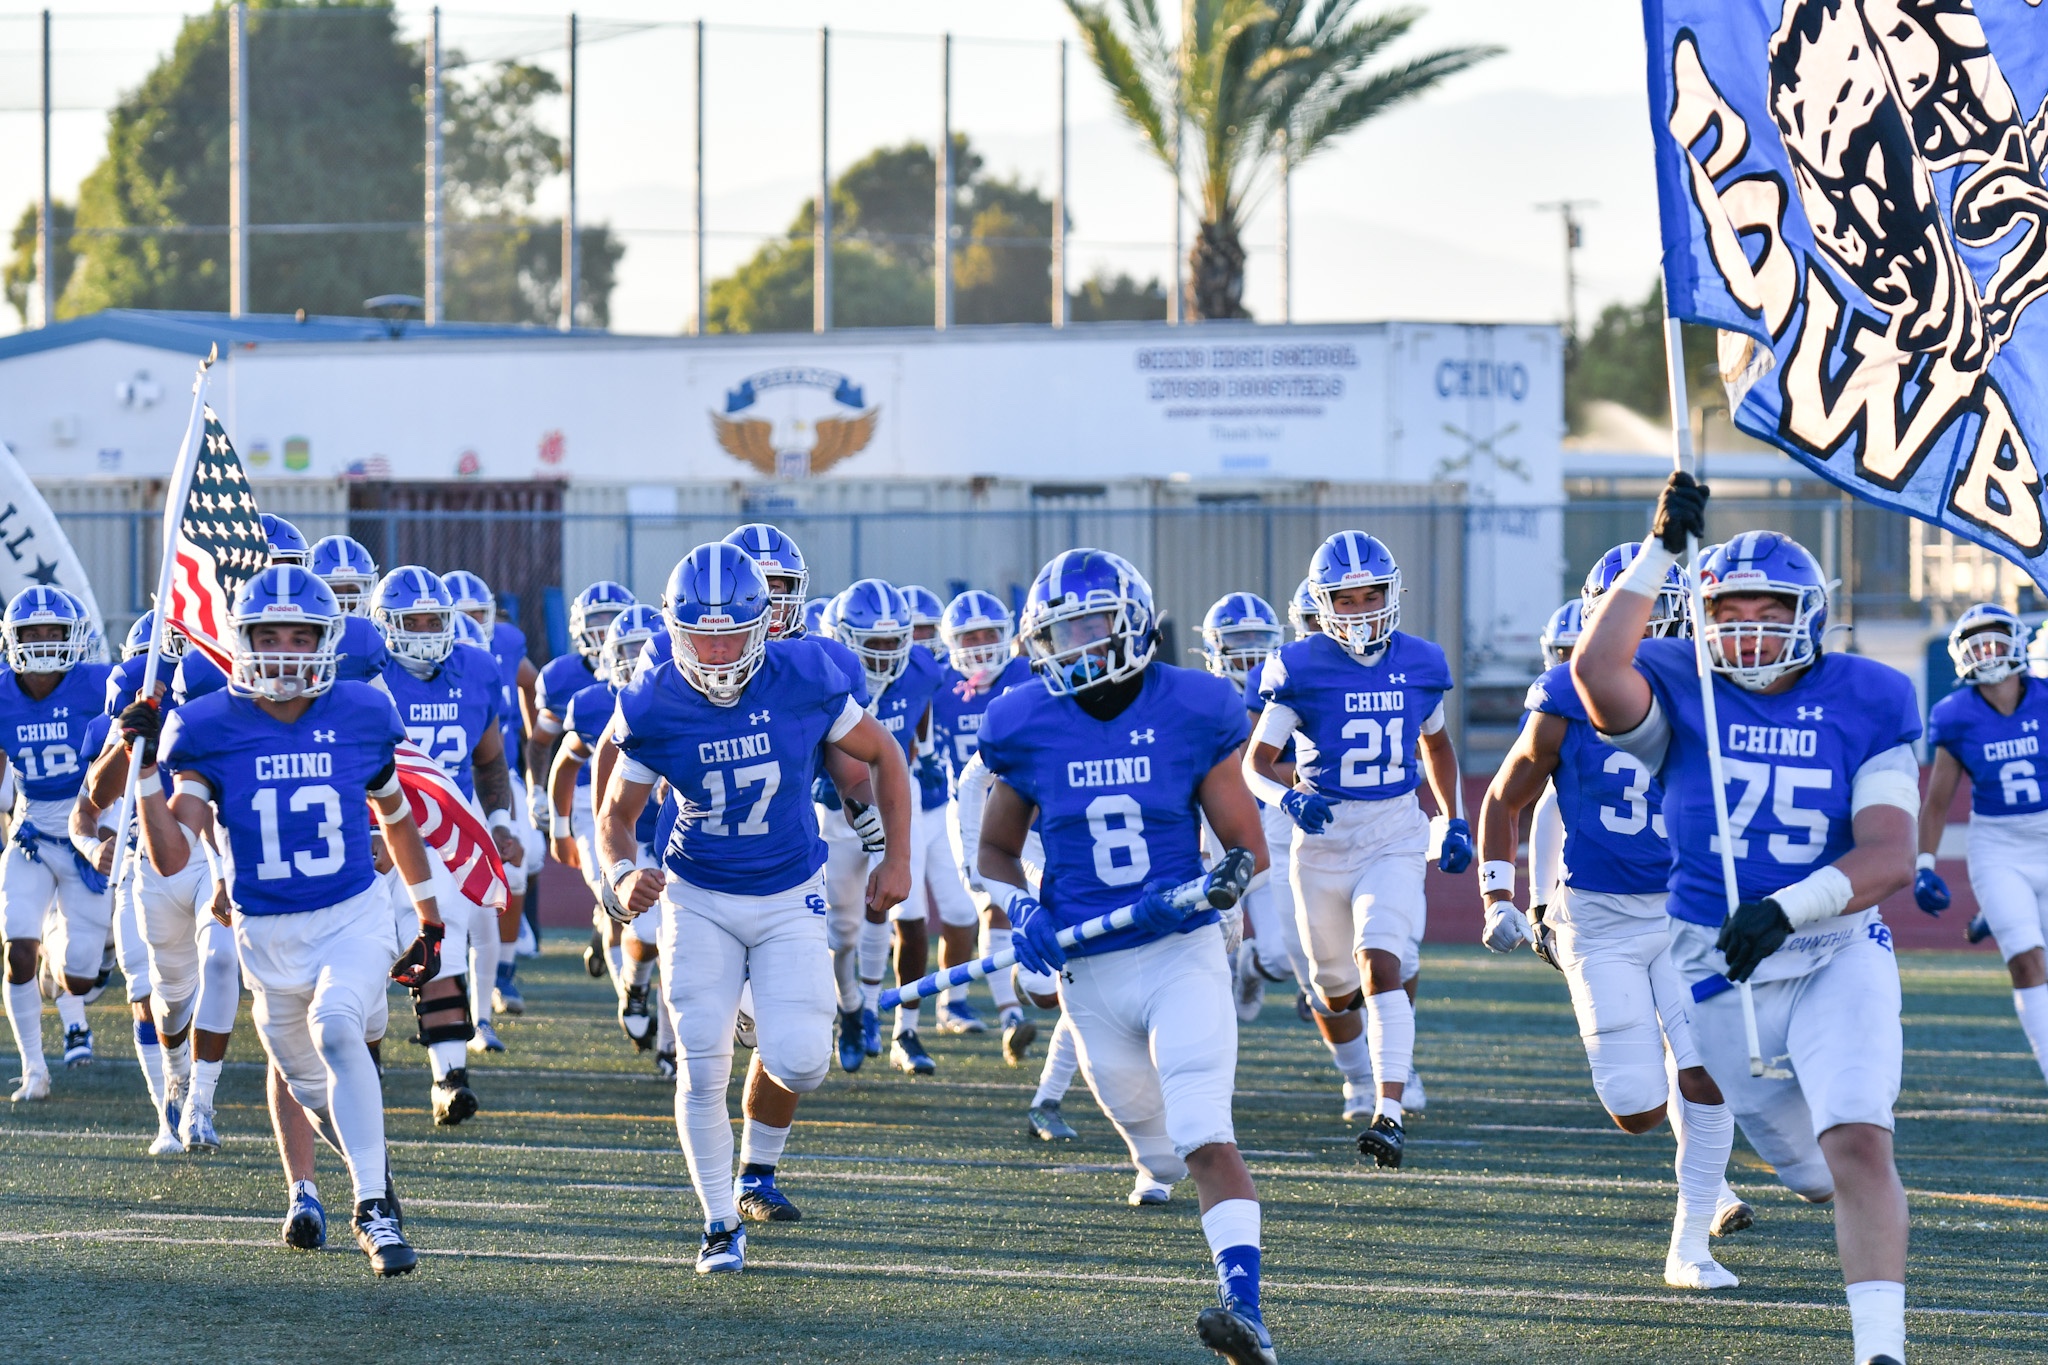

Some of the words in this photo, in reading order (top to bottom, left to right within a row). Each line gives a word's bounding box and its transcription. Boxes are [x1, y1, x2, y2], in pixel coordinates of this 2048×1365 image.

[1210, 346, 1265, 369] HIGH
[1269, 344, 1358, 368] SCHOOL
[1435, 359, 1530, 400] CHINO
[409, 703, 459, 721] CHINO
[1344, 690, 1404, 713] CHINO
[16, 722, 69, 742] CHINO
[698, 732, 771, 764] CHINO
[1728, 723, 1818, 758] CHINO
[1983, 735, 2039, 762] CHINO
[255, 752, 333, 781] CHINO
[1340, 717, 1406, 788] 21
[1067, 756, 1151, 788] CHINO
[1999, 758, 2041, 807] 6
[700, 760, 782, 837] 17
[1599, 750, 1668, 836] 3
[1709, 756, 1833, 865] 75
[251, 784, 346, 881] 13
[1085, 794, 1151, 887] 8
